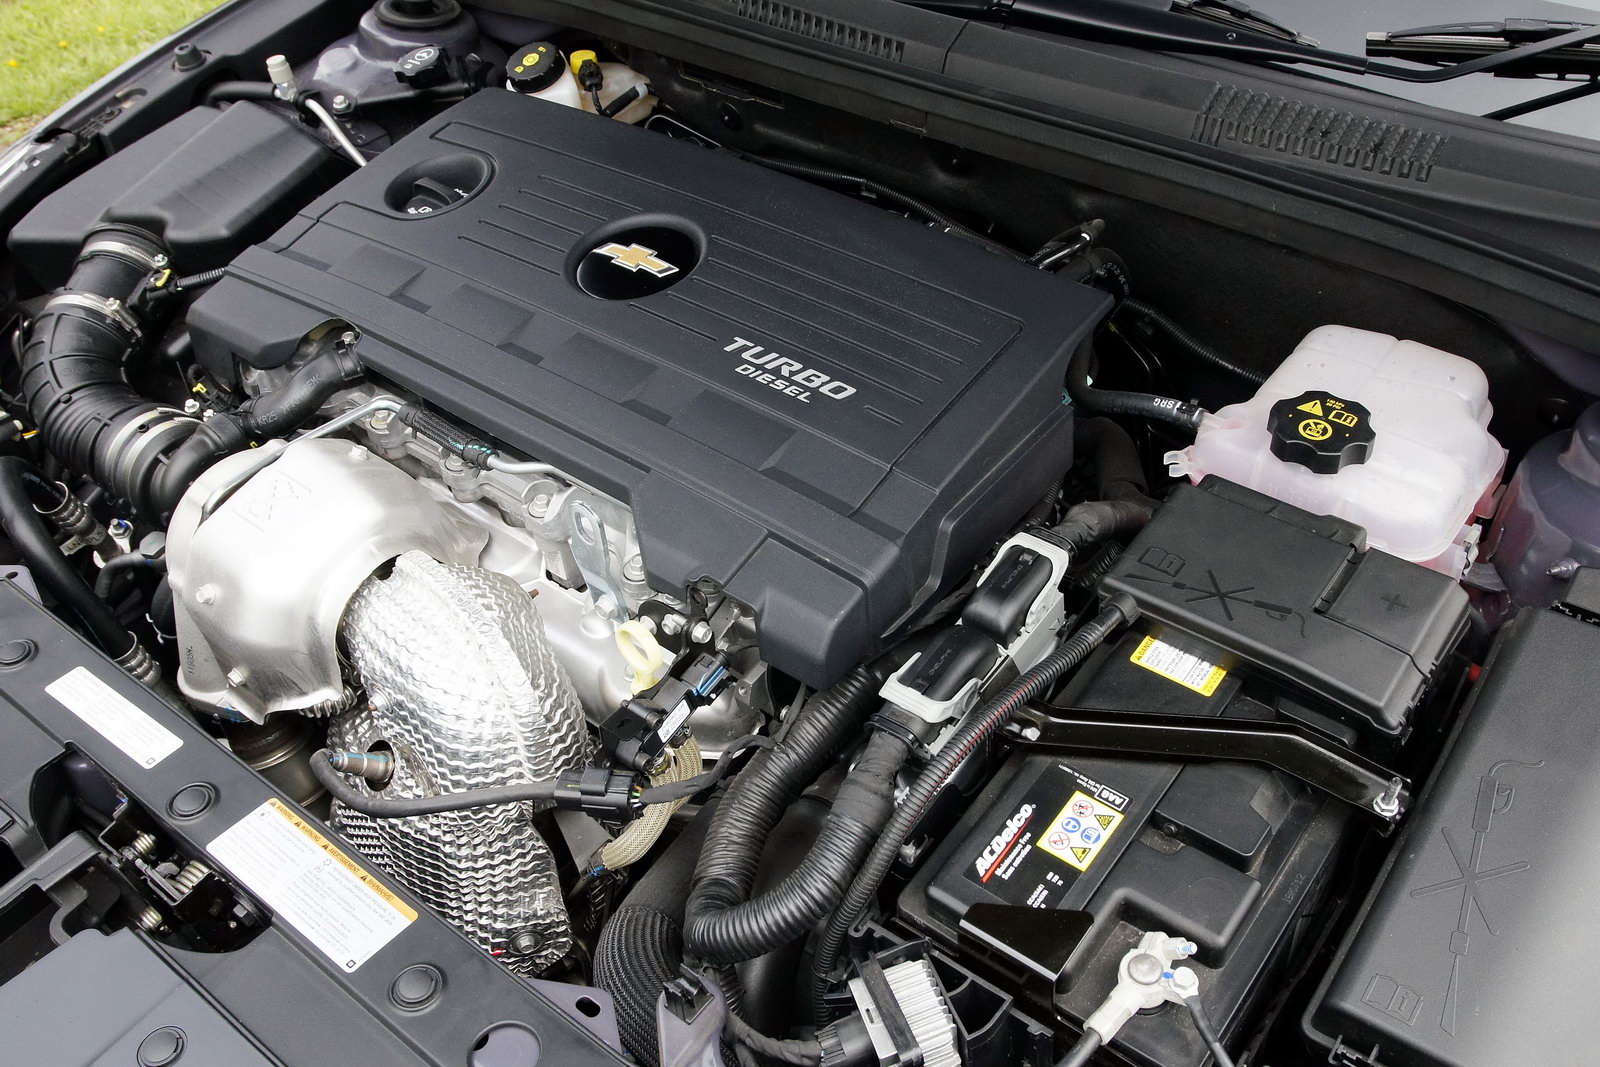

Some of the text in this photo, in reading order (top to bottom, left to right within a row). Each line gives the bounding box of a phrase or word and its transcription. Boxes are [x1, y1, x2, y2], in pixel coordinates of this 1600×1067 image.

[723, 336, 857, 400] TURBO
[734, 364, 812, 403] DIESEL
[975, 803, 1034, 877] ACDelco
[995, 832, 1032, 877] Maintenance Free
